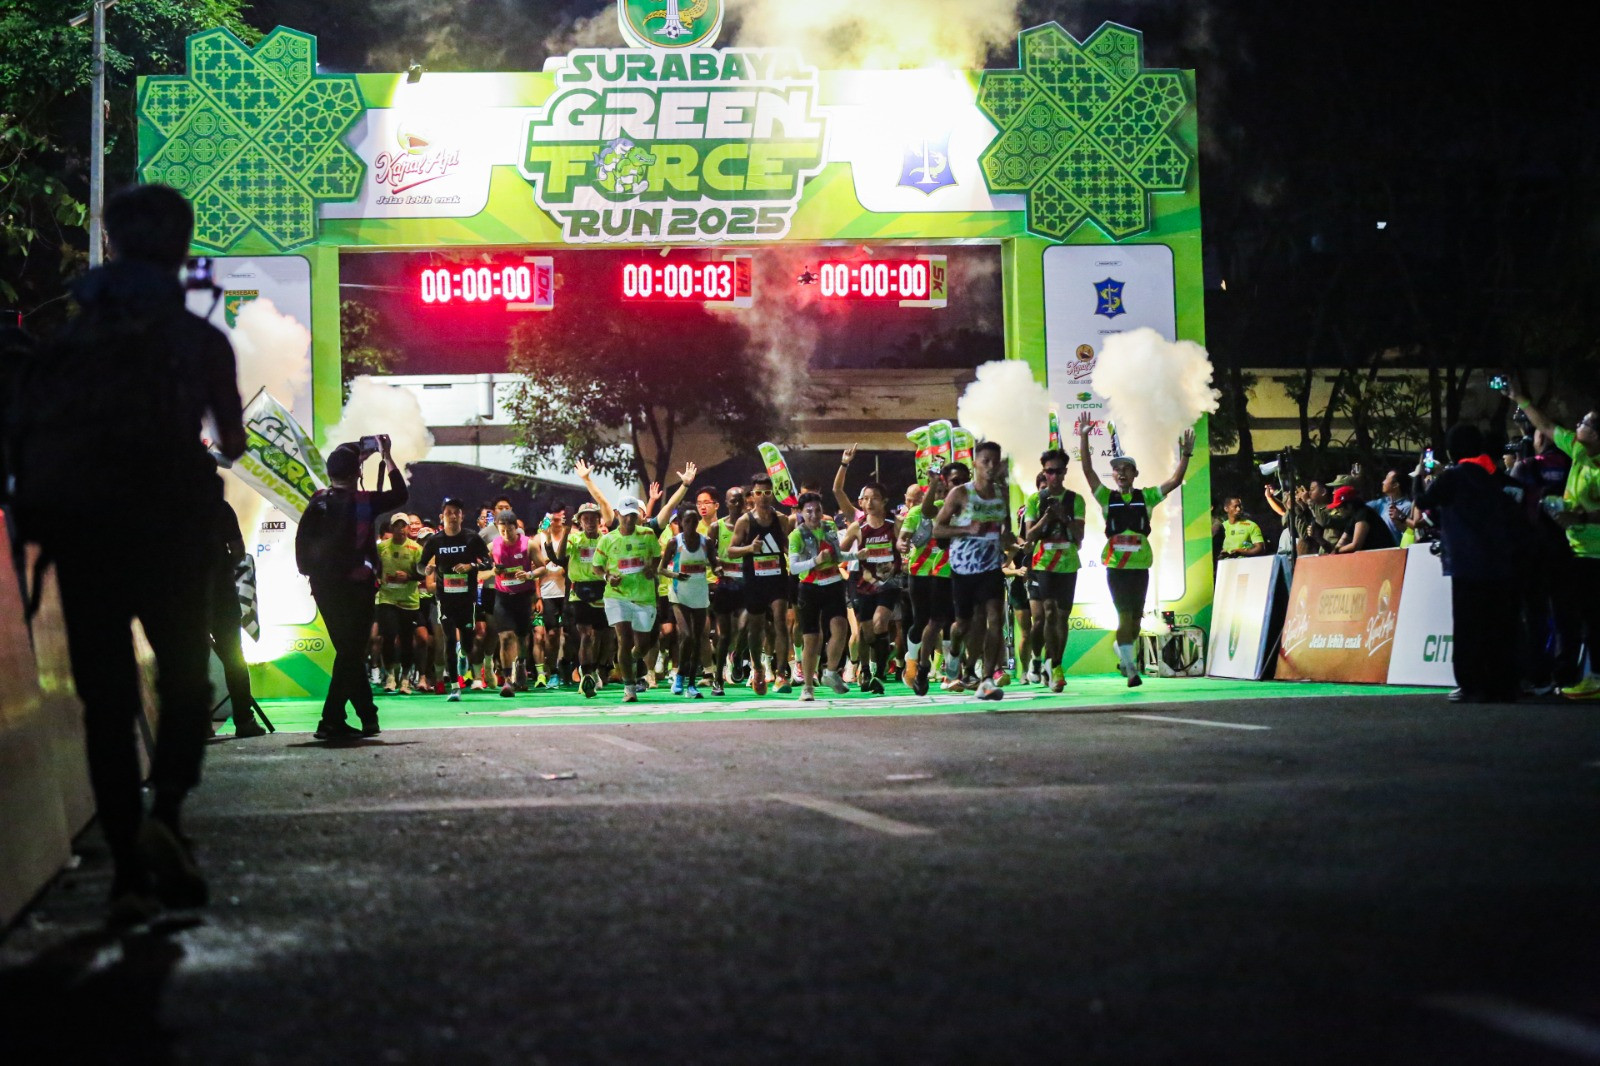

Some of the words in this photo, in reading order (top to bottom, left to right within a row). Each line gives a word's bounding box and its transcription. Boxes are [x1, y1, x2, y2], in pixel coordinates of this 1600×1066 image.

[562, 53, 812, 82] SURABAYA
[532, 90, 820, 141] GREEN
[530, 142, 817, 194] FORCE
[376, 195, 404, 204] Jelas
[405, 195, 433, 204] lebih
[434, 194, 461, 204] enak
[560, 207, 662, 237] RUN
[667, 206, 791, 235] 2025
[421, 266, 531, 303] 00:00:00
[623, 263, 731, 298] 00:00:03
[820, 263, 926, 297] 00:00:00
[439, 545, 467, 554] RIOT
[1319, 592, 1350, 616] SPECIAL
[1309, 634, 1327, 648] Jelas
[1327, 633, 1344, 648] lebih
[1345, 634, 1362, 648] enak
